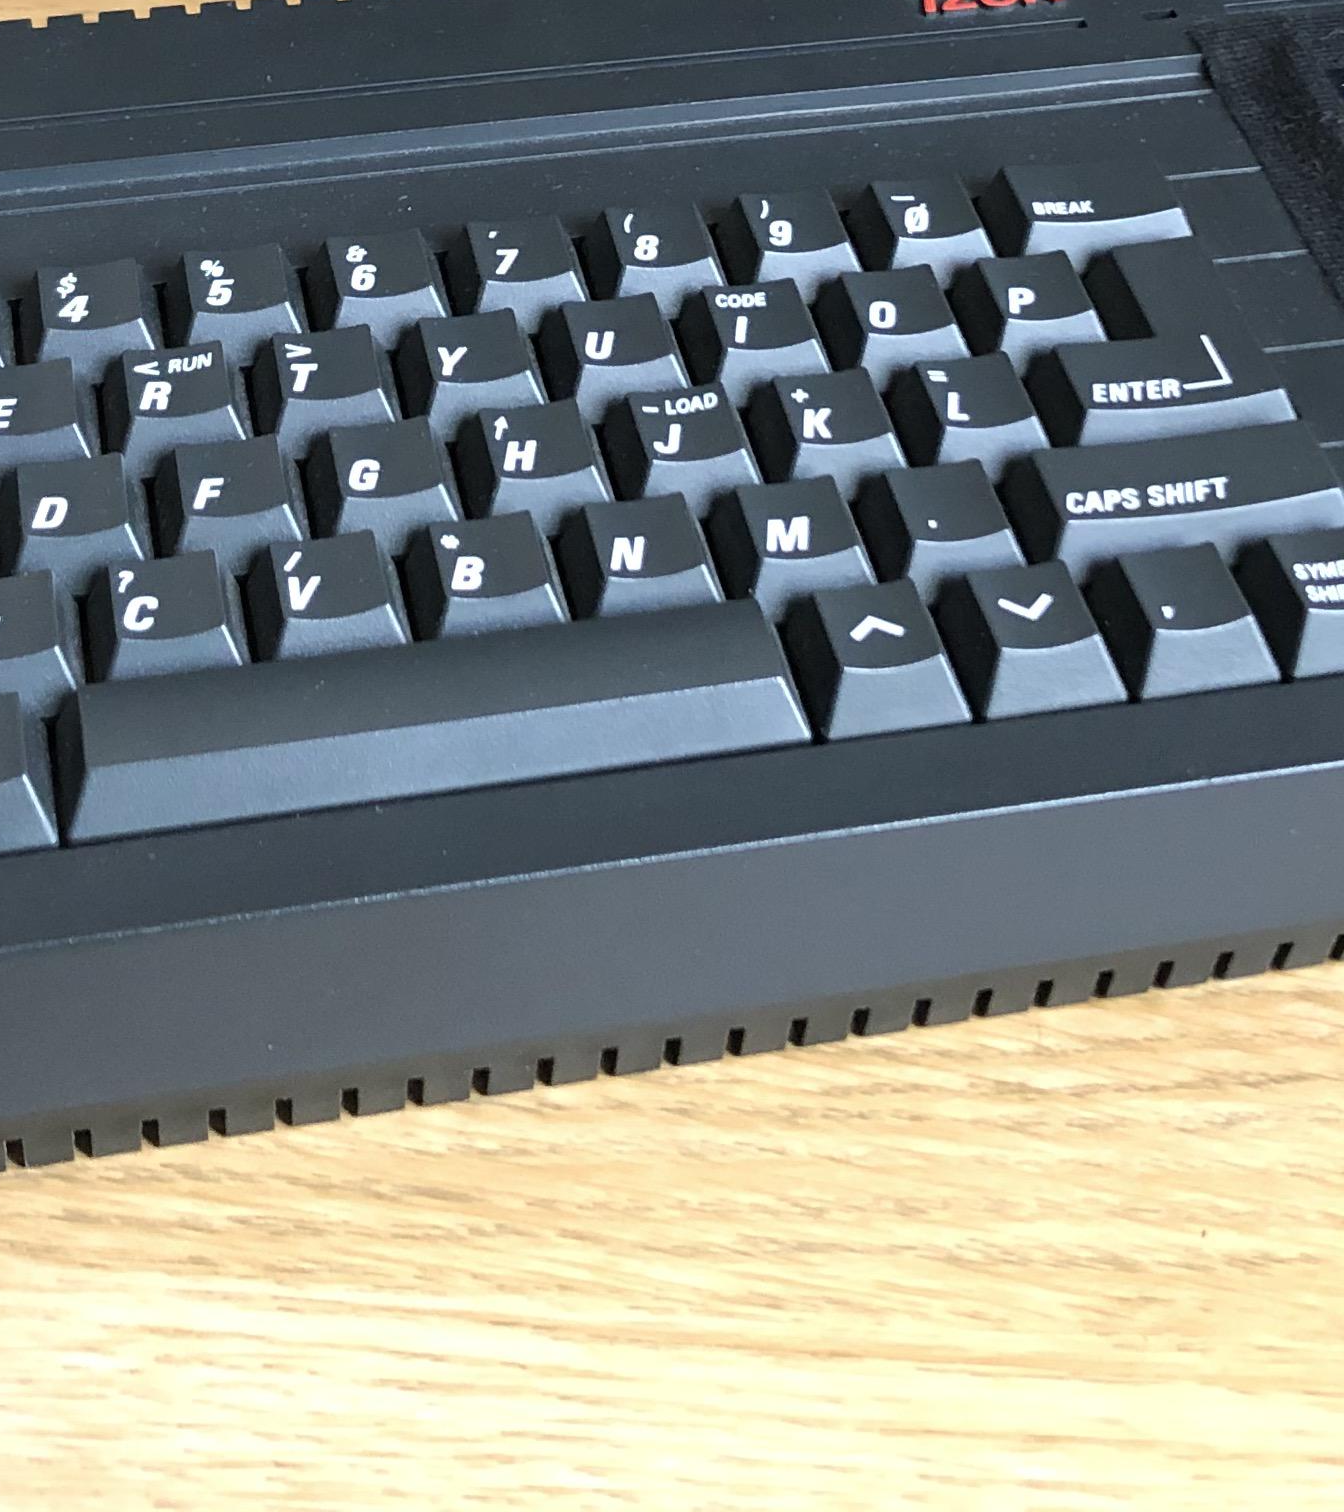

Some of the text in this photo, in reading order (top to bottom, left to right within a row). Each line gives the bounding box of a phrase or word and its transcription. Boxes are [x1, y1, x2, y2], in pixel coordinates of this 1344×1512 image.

[759, 199, 770, 220] )
[1031, 200, 1095, 216] BREAK
[623, 213, 634, 234] (
[768, 220, 793, 247] 9
[345, 244, 368, 263] &
[495, 248, 519, 275] 7
[633, 234, 660, 261] 8
[200, 259, 225, 278] %
[350, 264, 377, 291] 6
[56, 272, 78, 296] $
[205, 278, 235, 307] 5
[57, 295, 89, 323] 4
[714, 291, 767, 309] CODE
[1008, 287, 1036, 315] P
[868, 300, 897, 329] O
[734, 315, 749, 344] I
[584, 330, 615, 360] U
[167, 352, 213, 374] RUN
[437, 346, 468, 376] Y
[289, 363, 319, 392] T
[926, 370, 948, 383] =
[1092, 378, 1181, 403] ENTER
[138, 381, 172, 411] R
[664, 392, 719, 416] LOAD
[790, 388, 810, 404] +
[947, 391, 970, 422] L
[802, 407, 832, 439] K
[653, 423, 682, 455] J
[502, 439, 538, 472] H
[348, 458, 381, 492] G
[192, 477, 225, 510] F
[1065, 476, 1229, 514] CAPS SHIFT
[31, 496, 69, 530] D
[927, 519, 938, 529] .
[766, 515, 810, 553] M
[610, 535, 646, 571] N
[118, 570, 135, 594] ?
[450, 555, 485, 591] B
[287, 575, 322, 611] V
[123, 595, 159, 632] C
